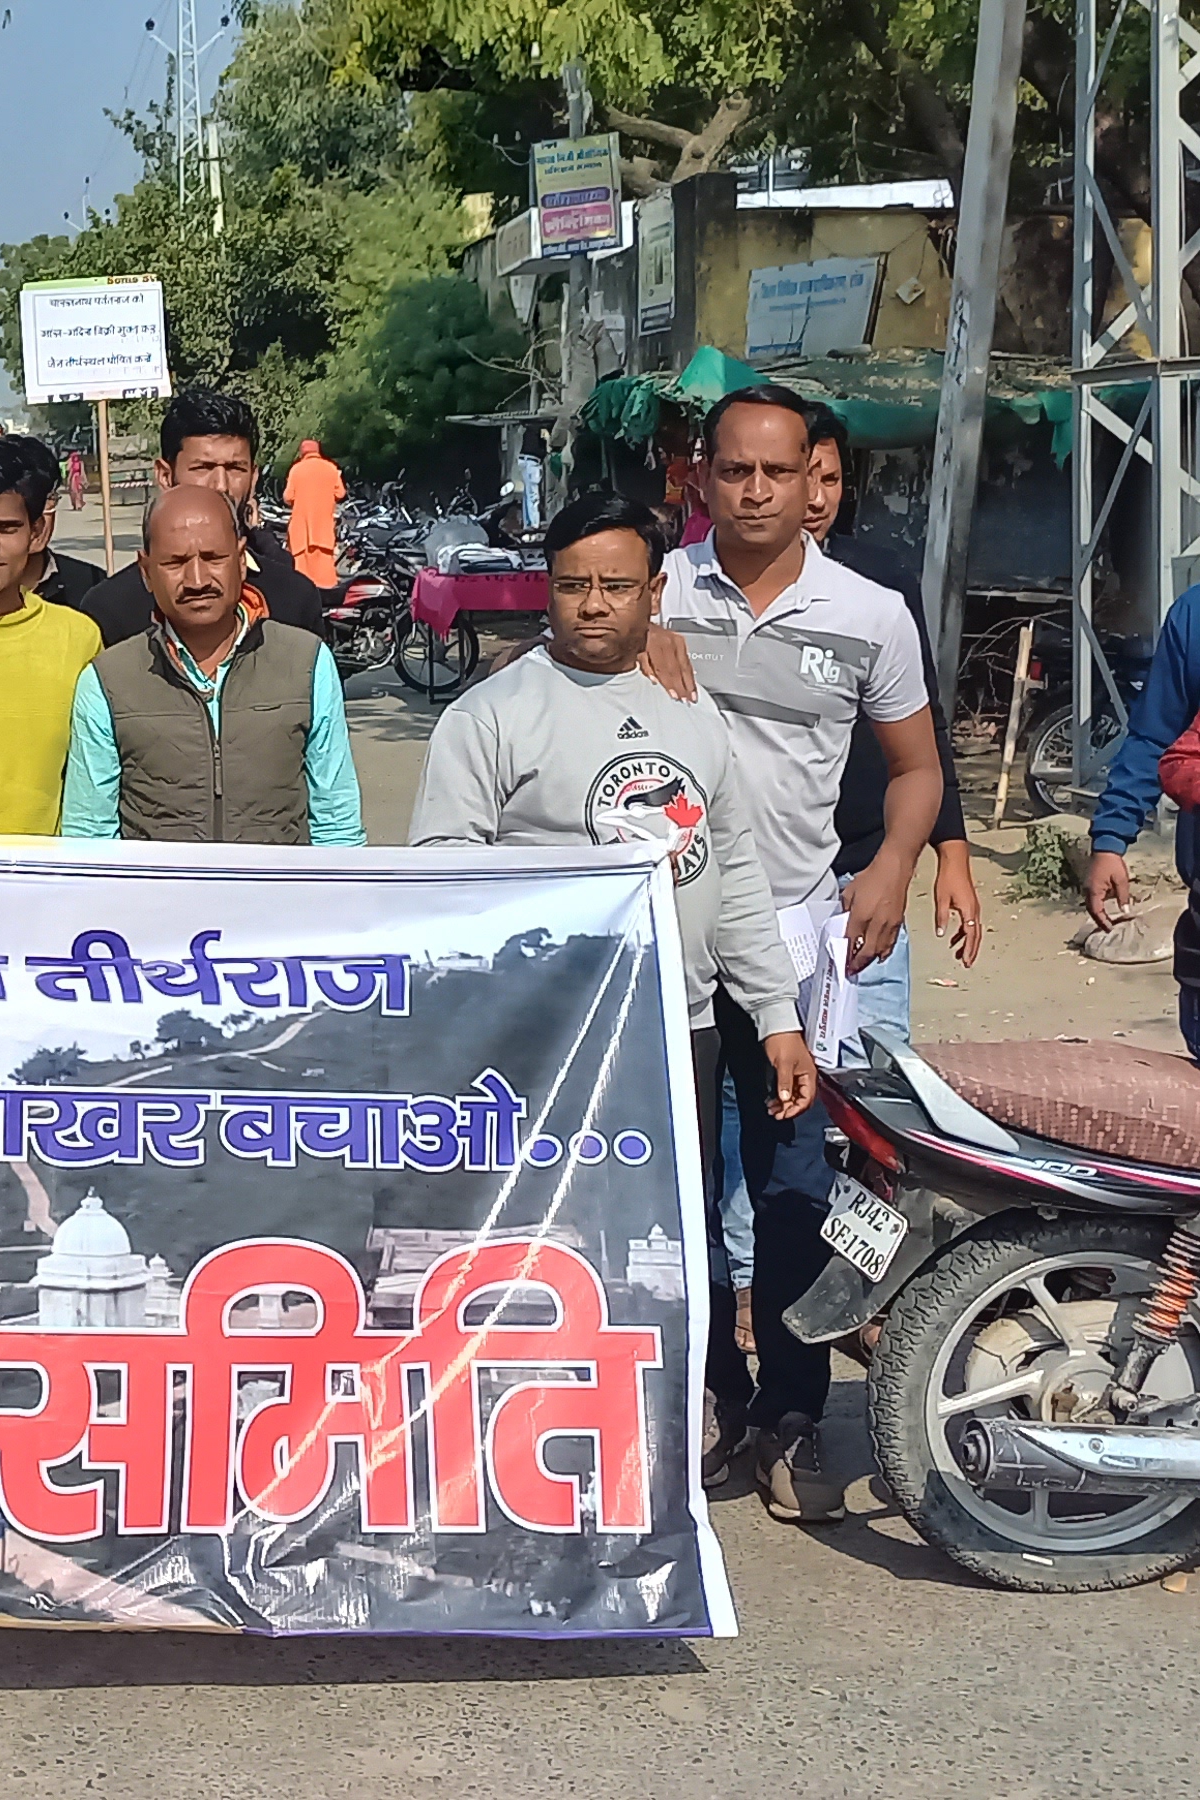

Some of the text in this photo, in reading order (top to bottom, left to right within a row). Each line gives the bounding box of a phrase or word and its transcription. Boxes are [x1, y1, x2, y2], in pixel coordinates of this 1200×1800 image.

[132, 293, 144, 304] को
[617, 730, 650, 740] adidas
[597, 761, 671, 807] TORONTO
[25, 930, 411, 1016] तीर्थराज
[848, 1191, 890, 1233] RJ42
